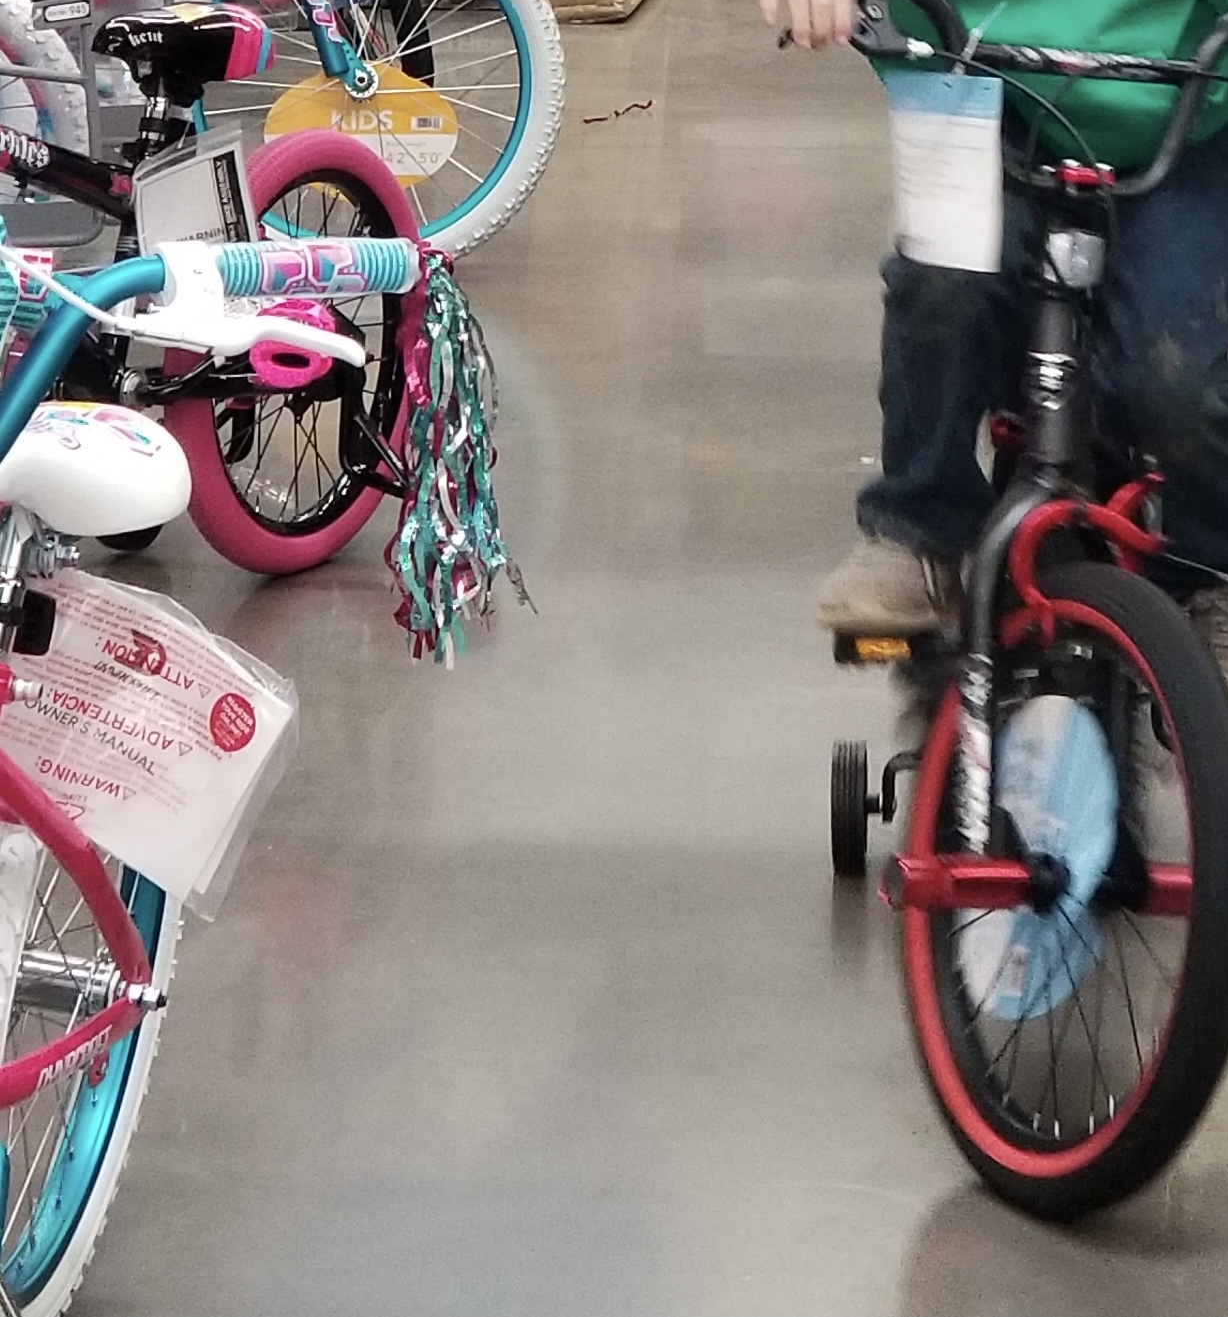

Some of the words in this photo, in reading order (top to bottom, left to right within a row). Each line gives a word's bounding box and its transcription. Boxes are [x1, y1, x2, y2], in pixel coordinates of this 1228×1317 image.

[127, 30, 164, 48] kent
[330, 109, 394, 131] KIDS
[93, 727, 157, 776] MANUAL
[35, 754, 122, 800] WARNING:
